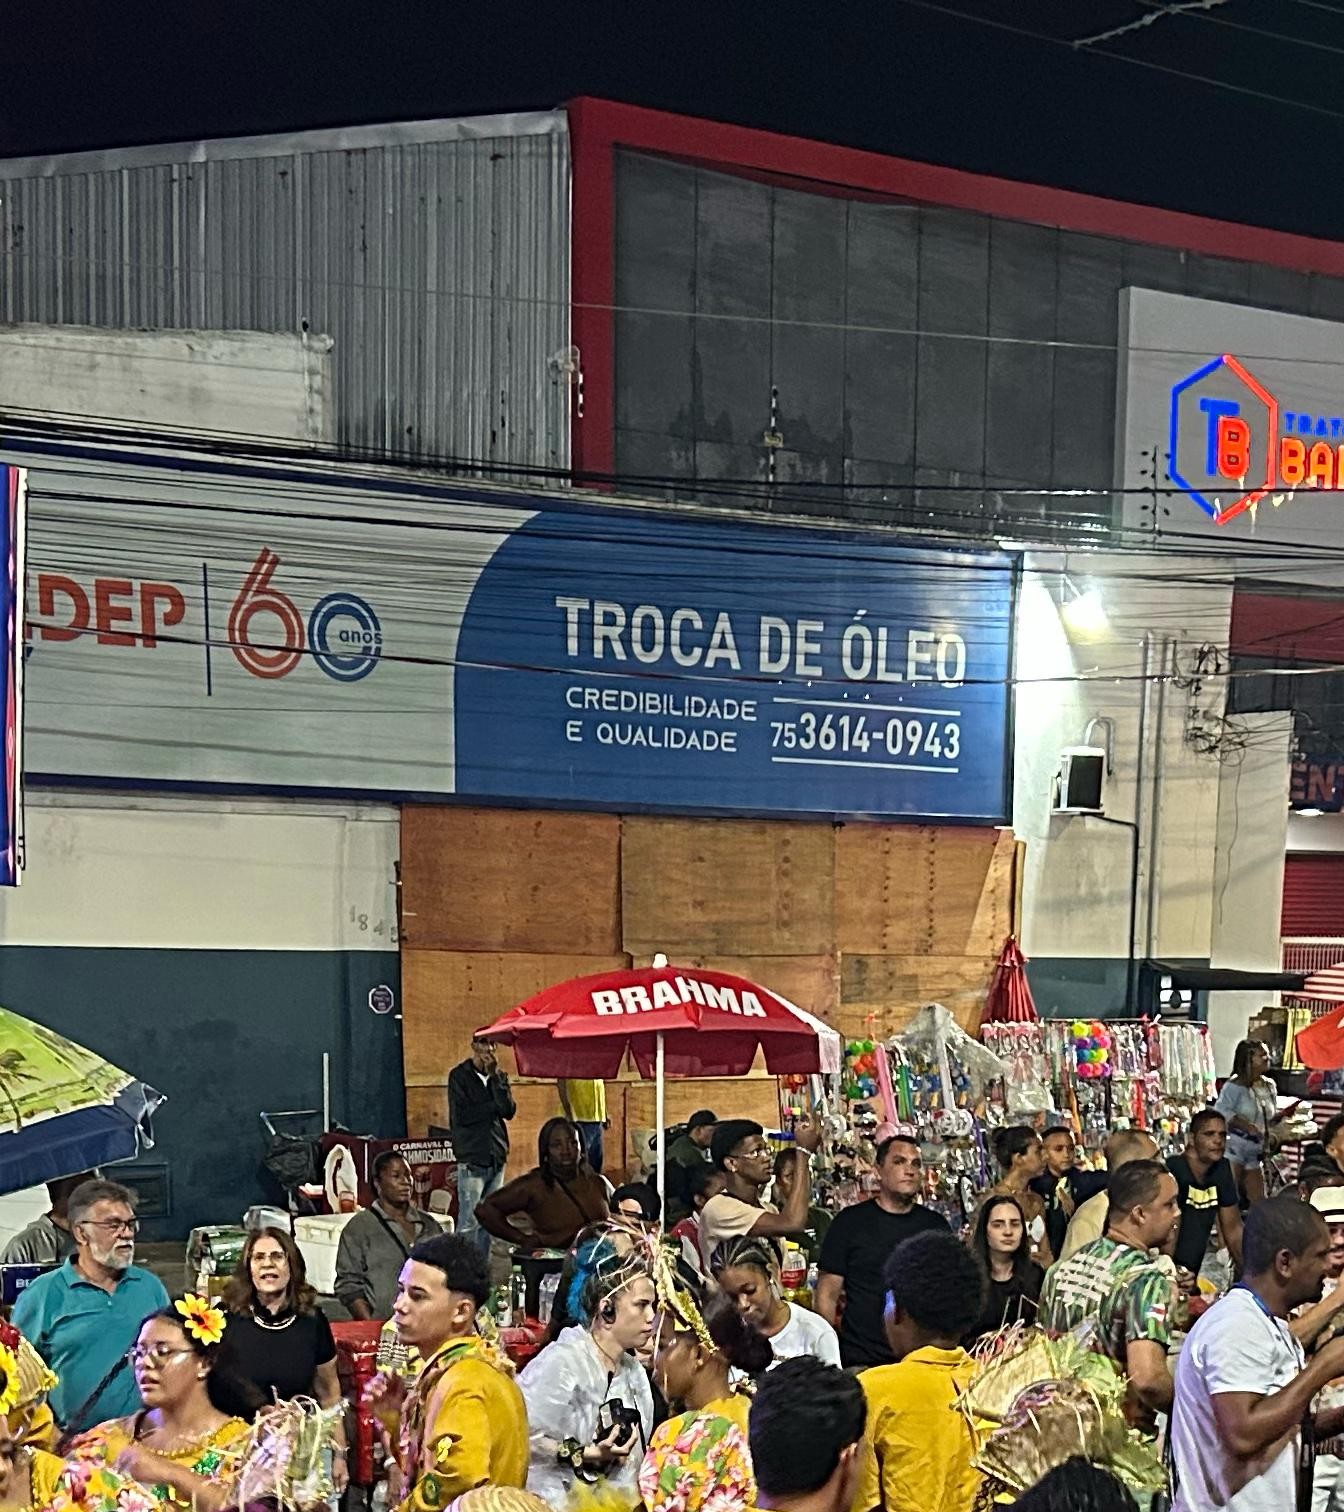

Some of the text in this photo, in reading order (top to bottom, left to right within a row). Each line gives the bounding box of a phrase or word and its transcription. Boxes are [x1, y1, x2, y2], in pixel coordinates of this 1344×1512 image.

[26, 573, 186, 649] DEP
[338, 627, 383, 646] anos
[555, 596, 967, 689] TROCA DE ÓLEO
[565, 686, 758, 722] CREDIBILIDADE
[565, 720, 738, 753] E QUALIDADE
[798, 711, 961, 760] 3614-0943
[590, 976, 768, 1019] BRAHMA
[399, 1141, 442, 1150] CARNAVAL
